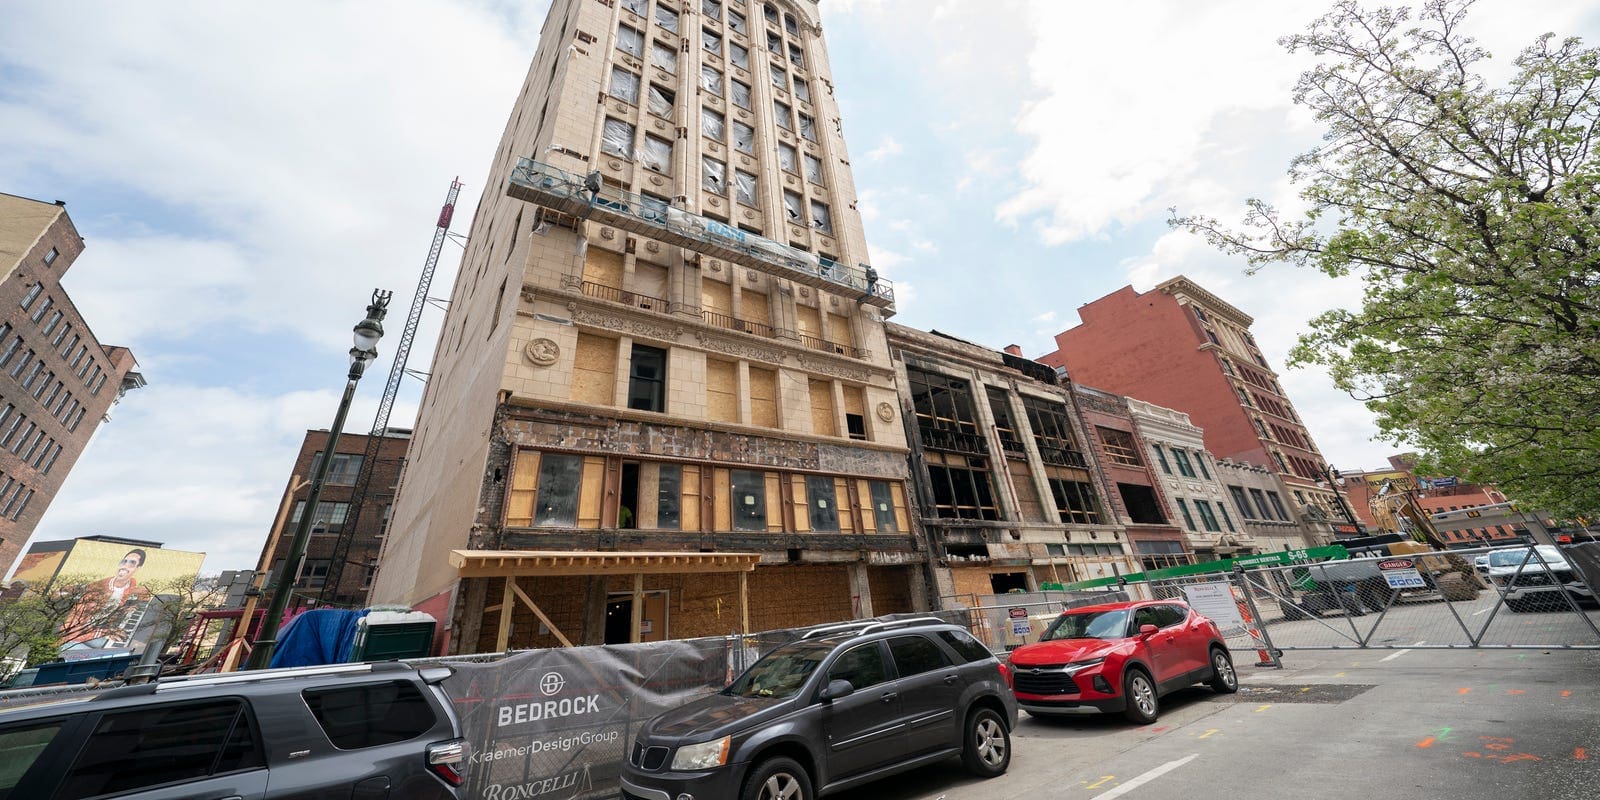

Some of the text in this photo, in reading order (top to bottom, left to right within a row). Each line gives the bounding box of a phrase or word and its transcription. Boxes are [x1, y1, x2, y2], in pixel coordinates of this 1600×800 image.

[1287, 550, 1308, 560] S-65
[498, 694, 600, 727] BEDROCK
[468, 730, 618, 765] KraemerDesignGroup
[482, 771, 578, 800] RONCELLI
